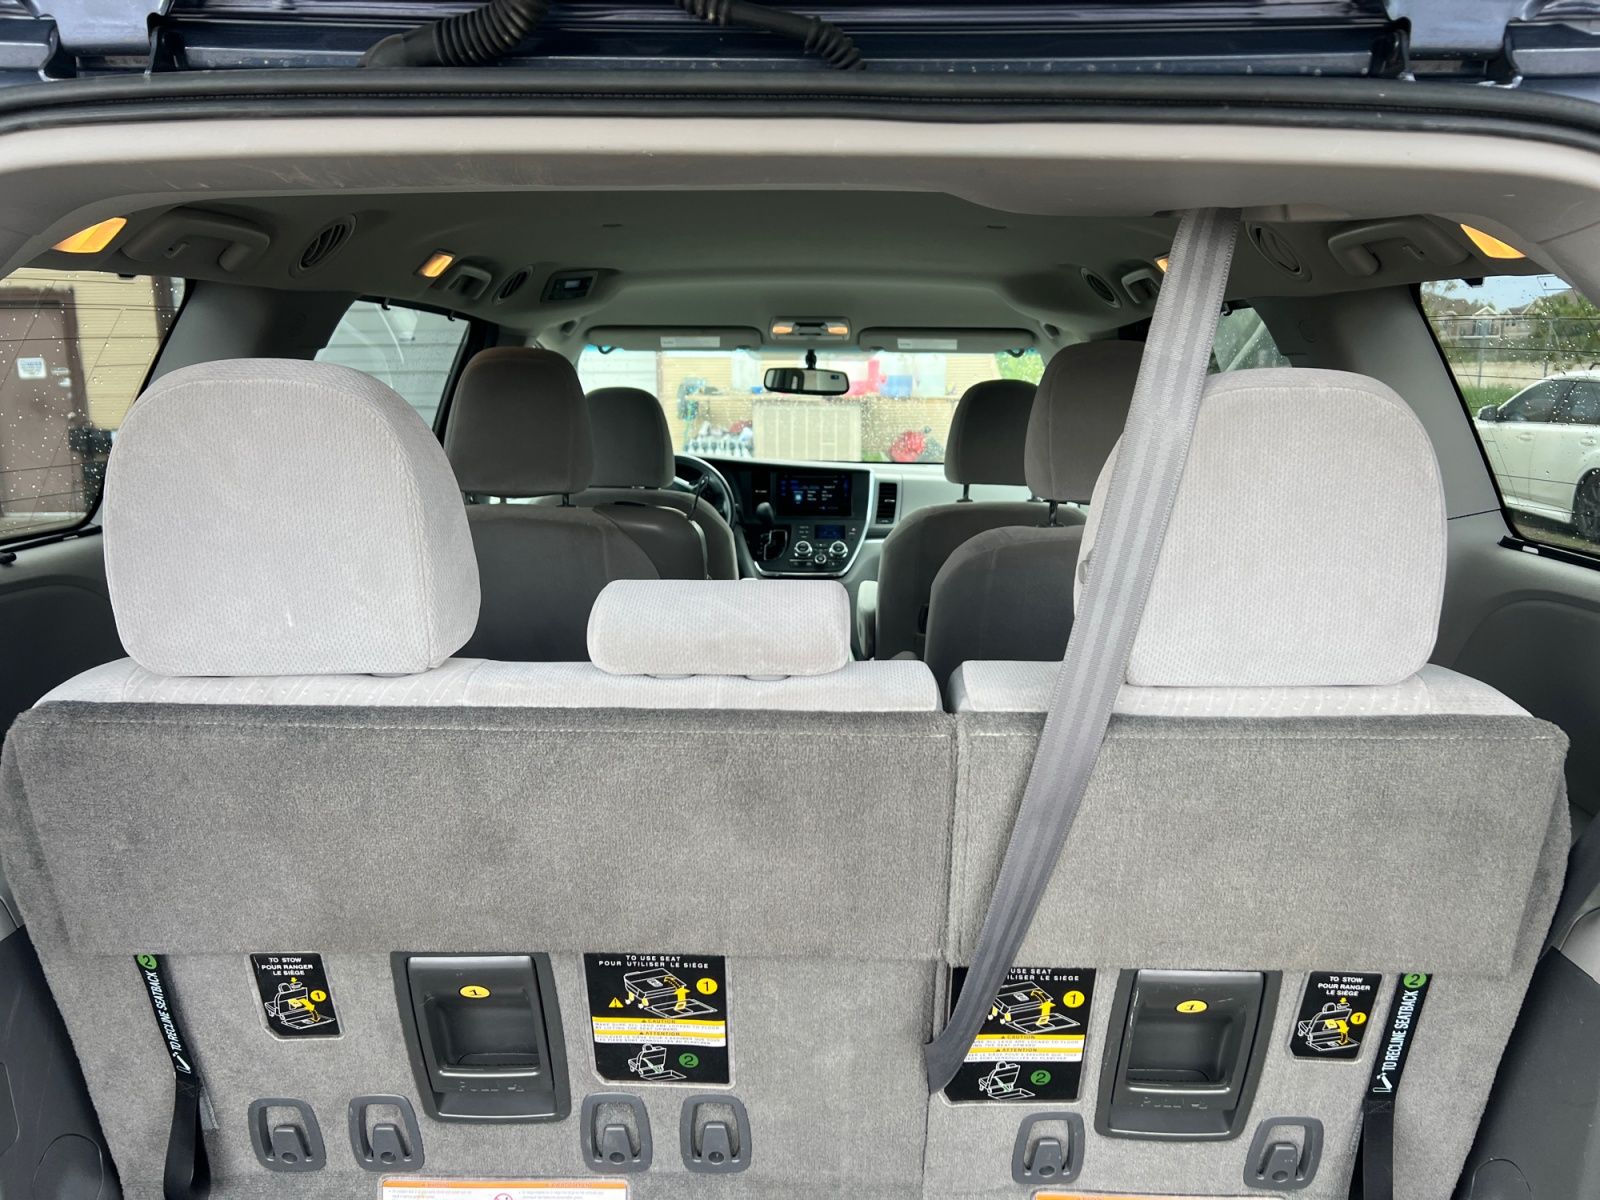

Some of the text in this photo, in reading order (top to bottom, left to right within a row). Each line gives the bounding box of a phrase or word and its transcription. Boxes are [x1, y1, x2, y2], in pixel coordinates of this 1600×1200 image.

[145, 970, 168, 1010] SEATBACK
[1340, 983, 1371, 991] RANGER
[1409, 974, 1420, 986] 2
[158, 1010, 178, 1042] RECLINE
[1382, 990, 1419, 1070] TO RECLINE SEATBACK
